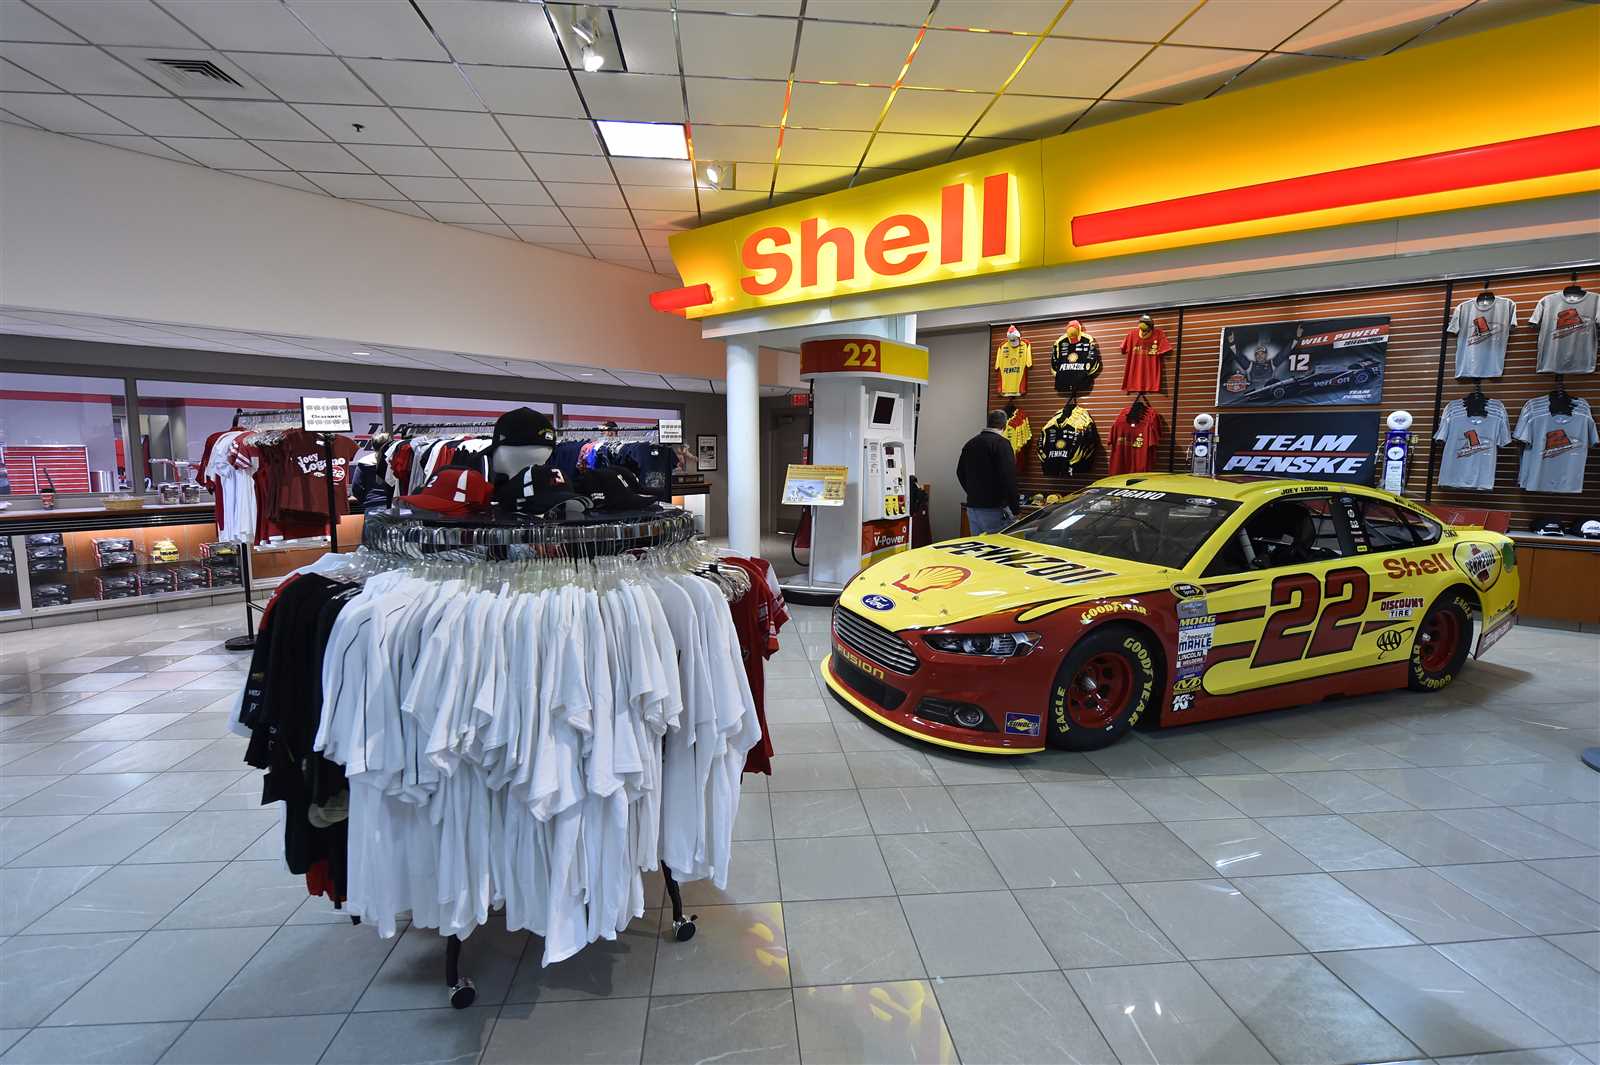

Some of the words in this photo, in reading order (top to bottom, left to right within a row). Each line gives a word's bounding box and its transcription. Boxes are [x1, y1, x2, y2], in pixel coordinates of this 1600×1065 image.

[740, 172, 1009, 296] Shell
[1300, 335, 1329, 346] WILL
[1333, 327, 1380, 341] POWER
[842, 342, 877, 367] 22
[1288, 353, 1310, 372] 12
[1252, 434, 1358, 451] TEAM
[297, 452, 319, 467] Joey
[300, 457, 346, 474] Logno
[1222, 455, 1367, 474] PENSKE
[1106, 488, 1167, 501] LOGANO
[1280, 488, 1299, 496] JOEY
[1300, 485, 1329, 493] LOGANO
[874, 534, 905, 547] V-Power
[932, 541, 1119, 584] PENNZOIL
[1382, 552, 1456, 580] Shell
[1080, 600, 1148, 624] GOODYEAR
[1380, 598, 1424, 611] DISCOUNT
[1390, 609, 1410, 618] TIRE
[1180, 616, 1216, 626] MOOG
[1249, 565, 1371, 669] 22
[1180, 638, 1212, 651] MAHLE
[1380, 629, 1401, 645] AAA
[1123, 636, 1155, 728] GOODYEAR
[1055, 686, 1072, 734] EAGLE
